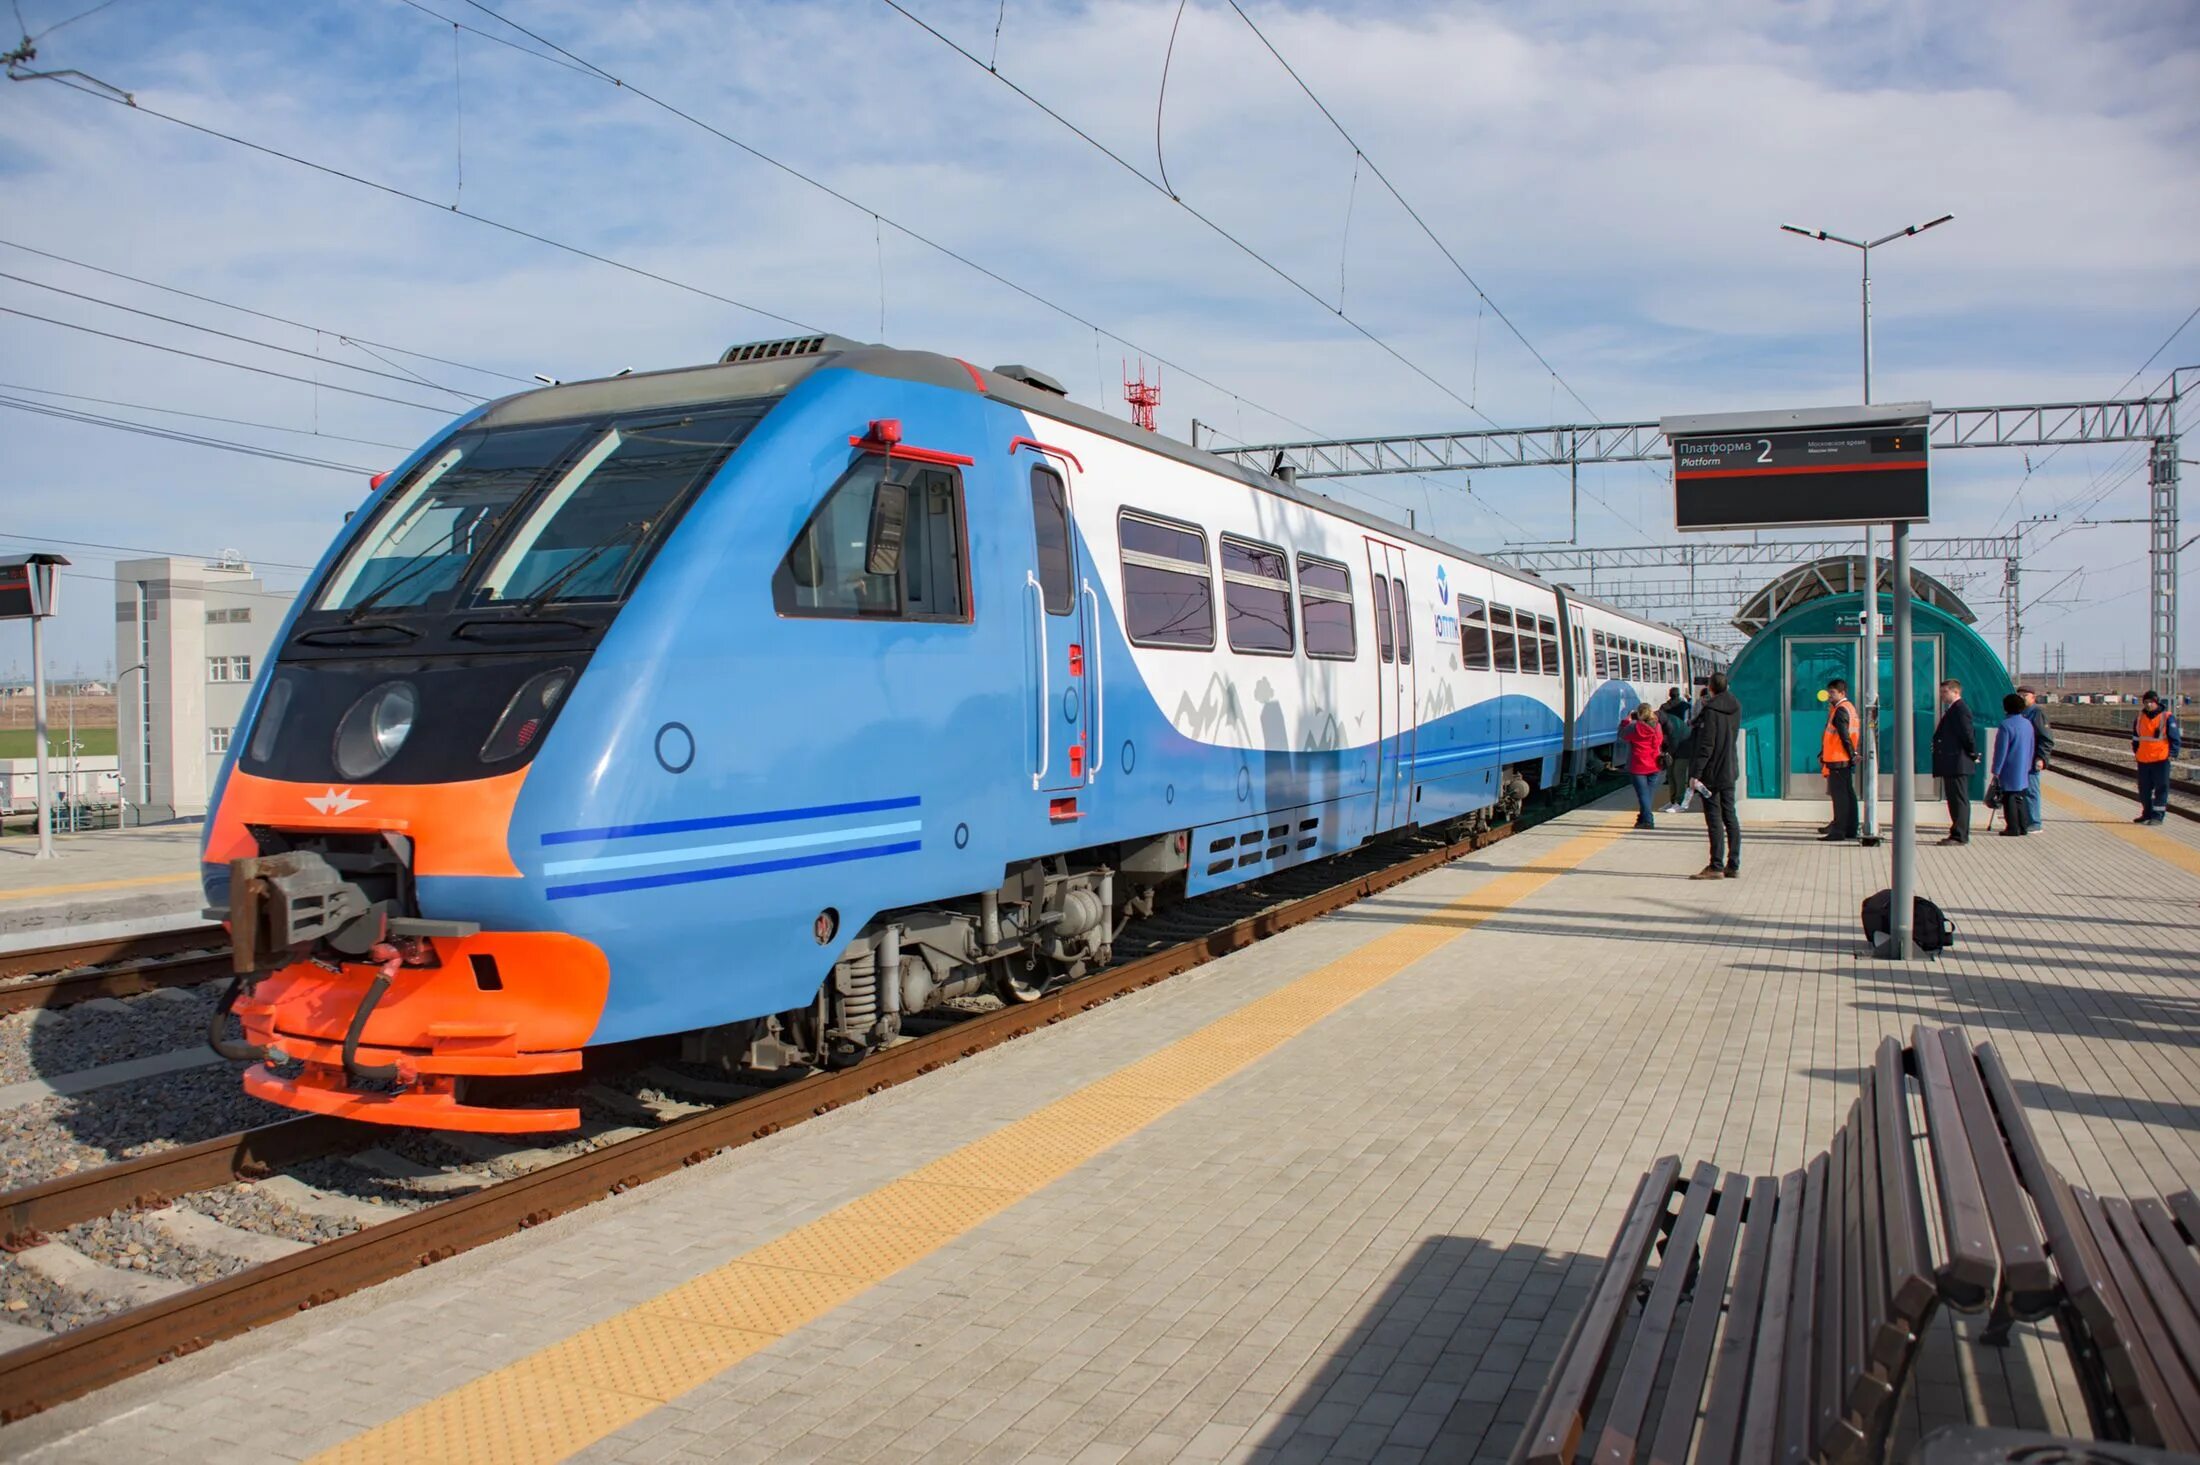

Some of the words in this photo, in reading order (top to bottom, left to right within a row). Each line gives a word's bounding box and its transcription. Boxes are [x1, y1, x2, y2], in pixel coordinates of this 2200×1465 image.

[1680, 442, 1752, 455] Платформа
[1757, 439, 1773, 463] 2
[1681, 457, 1721, 467] Platform
